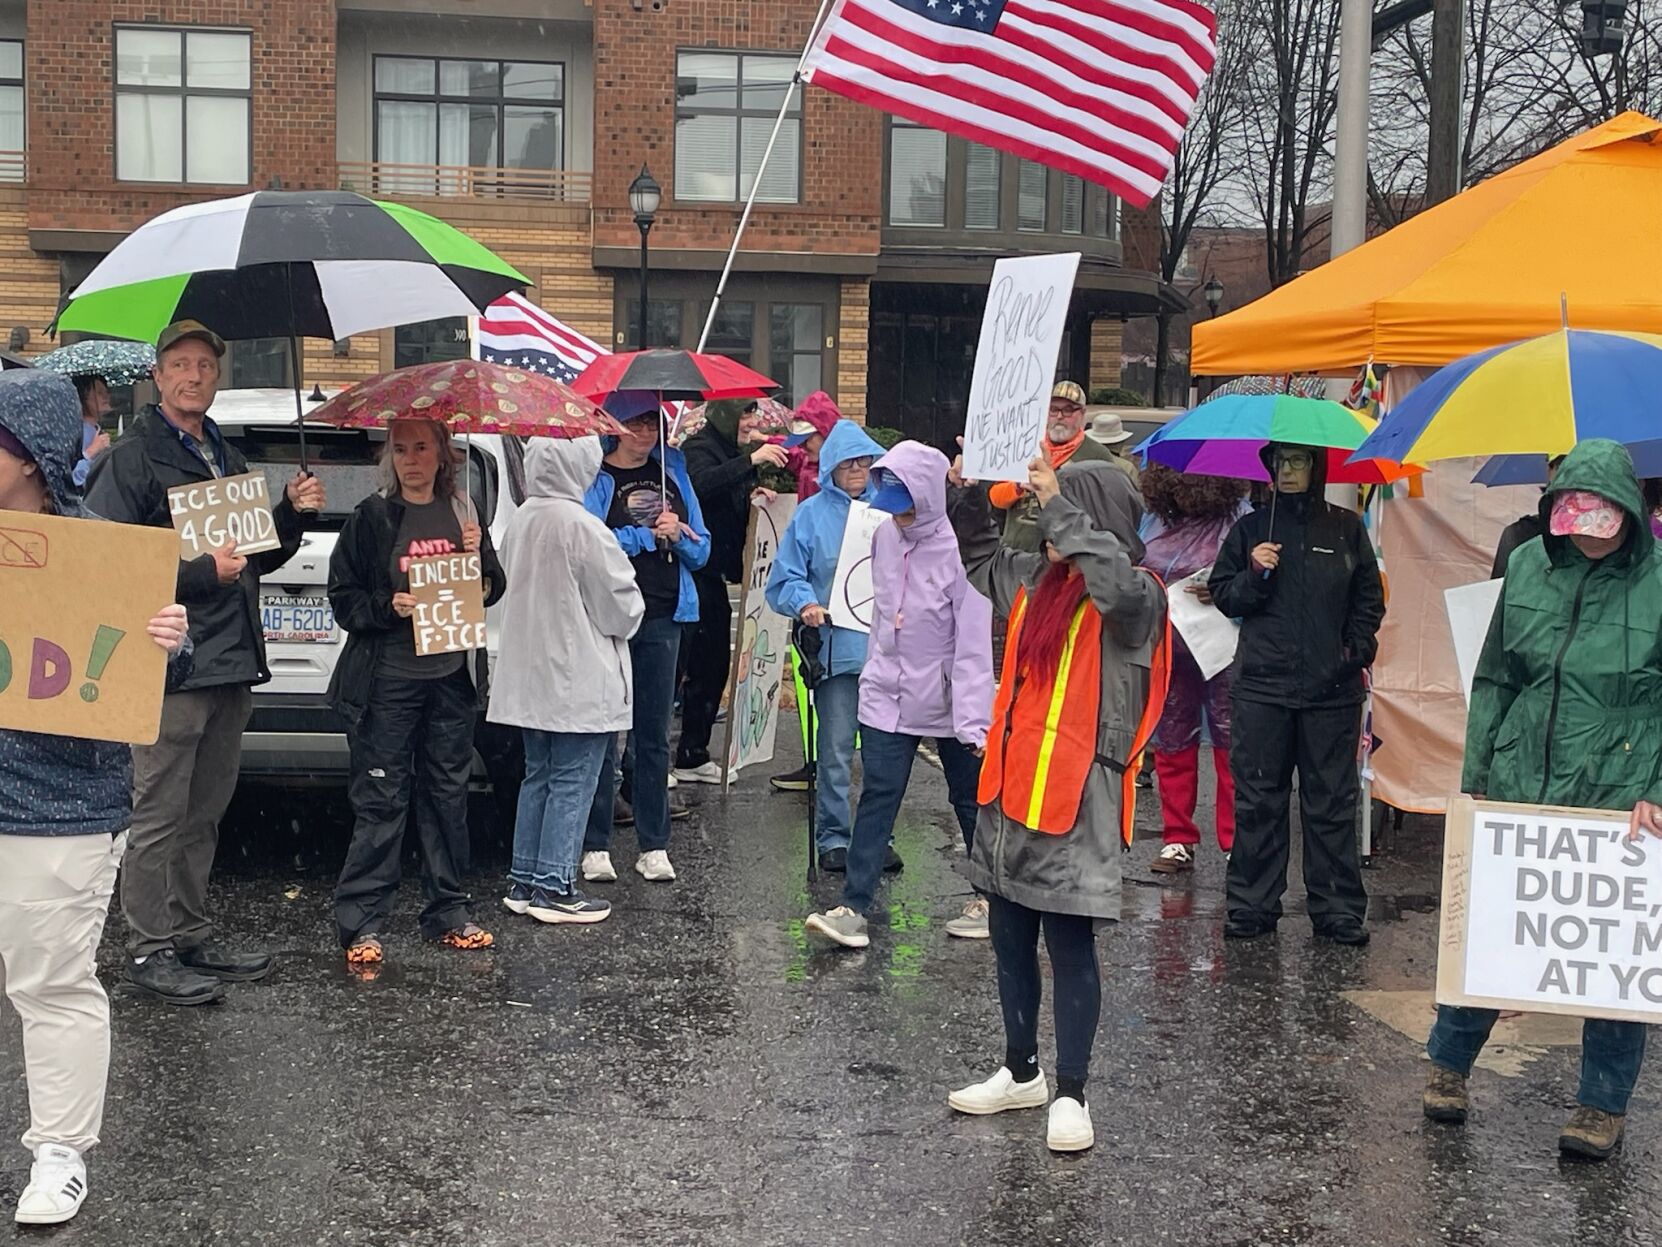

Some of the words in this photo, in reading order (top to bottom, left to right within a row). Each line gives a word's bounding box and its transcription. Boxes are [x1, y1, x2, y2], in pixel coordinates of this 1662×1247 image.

[982, 347, 1044, 411] GOOD
[970, 411, 992, 444] WE
[996, 397, 1039, 436] WANT
[169, 485, 221, 516] ICE
[225, 476, 266, 502] OUT
[180, 519, 199, 551] 4
[204, 507, 274, 548] GOOD
[408, 538, 457, 556] ANTI-
[410, 555, 481, 588] INCELS
[267, 596, 321, 606] PARKWAY
[415, 600, 465, 627] ICE
[1484, 821, 1647, 867] THAT'S
[1515, 867, 1662, 918] DUDE,
[1514, 911, 1620, 953] NOT
[1536, 958, 1598, 996] AT
